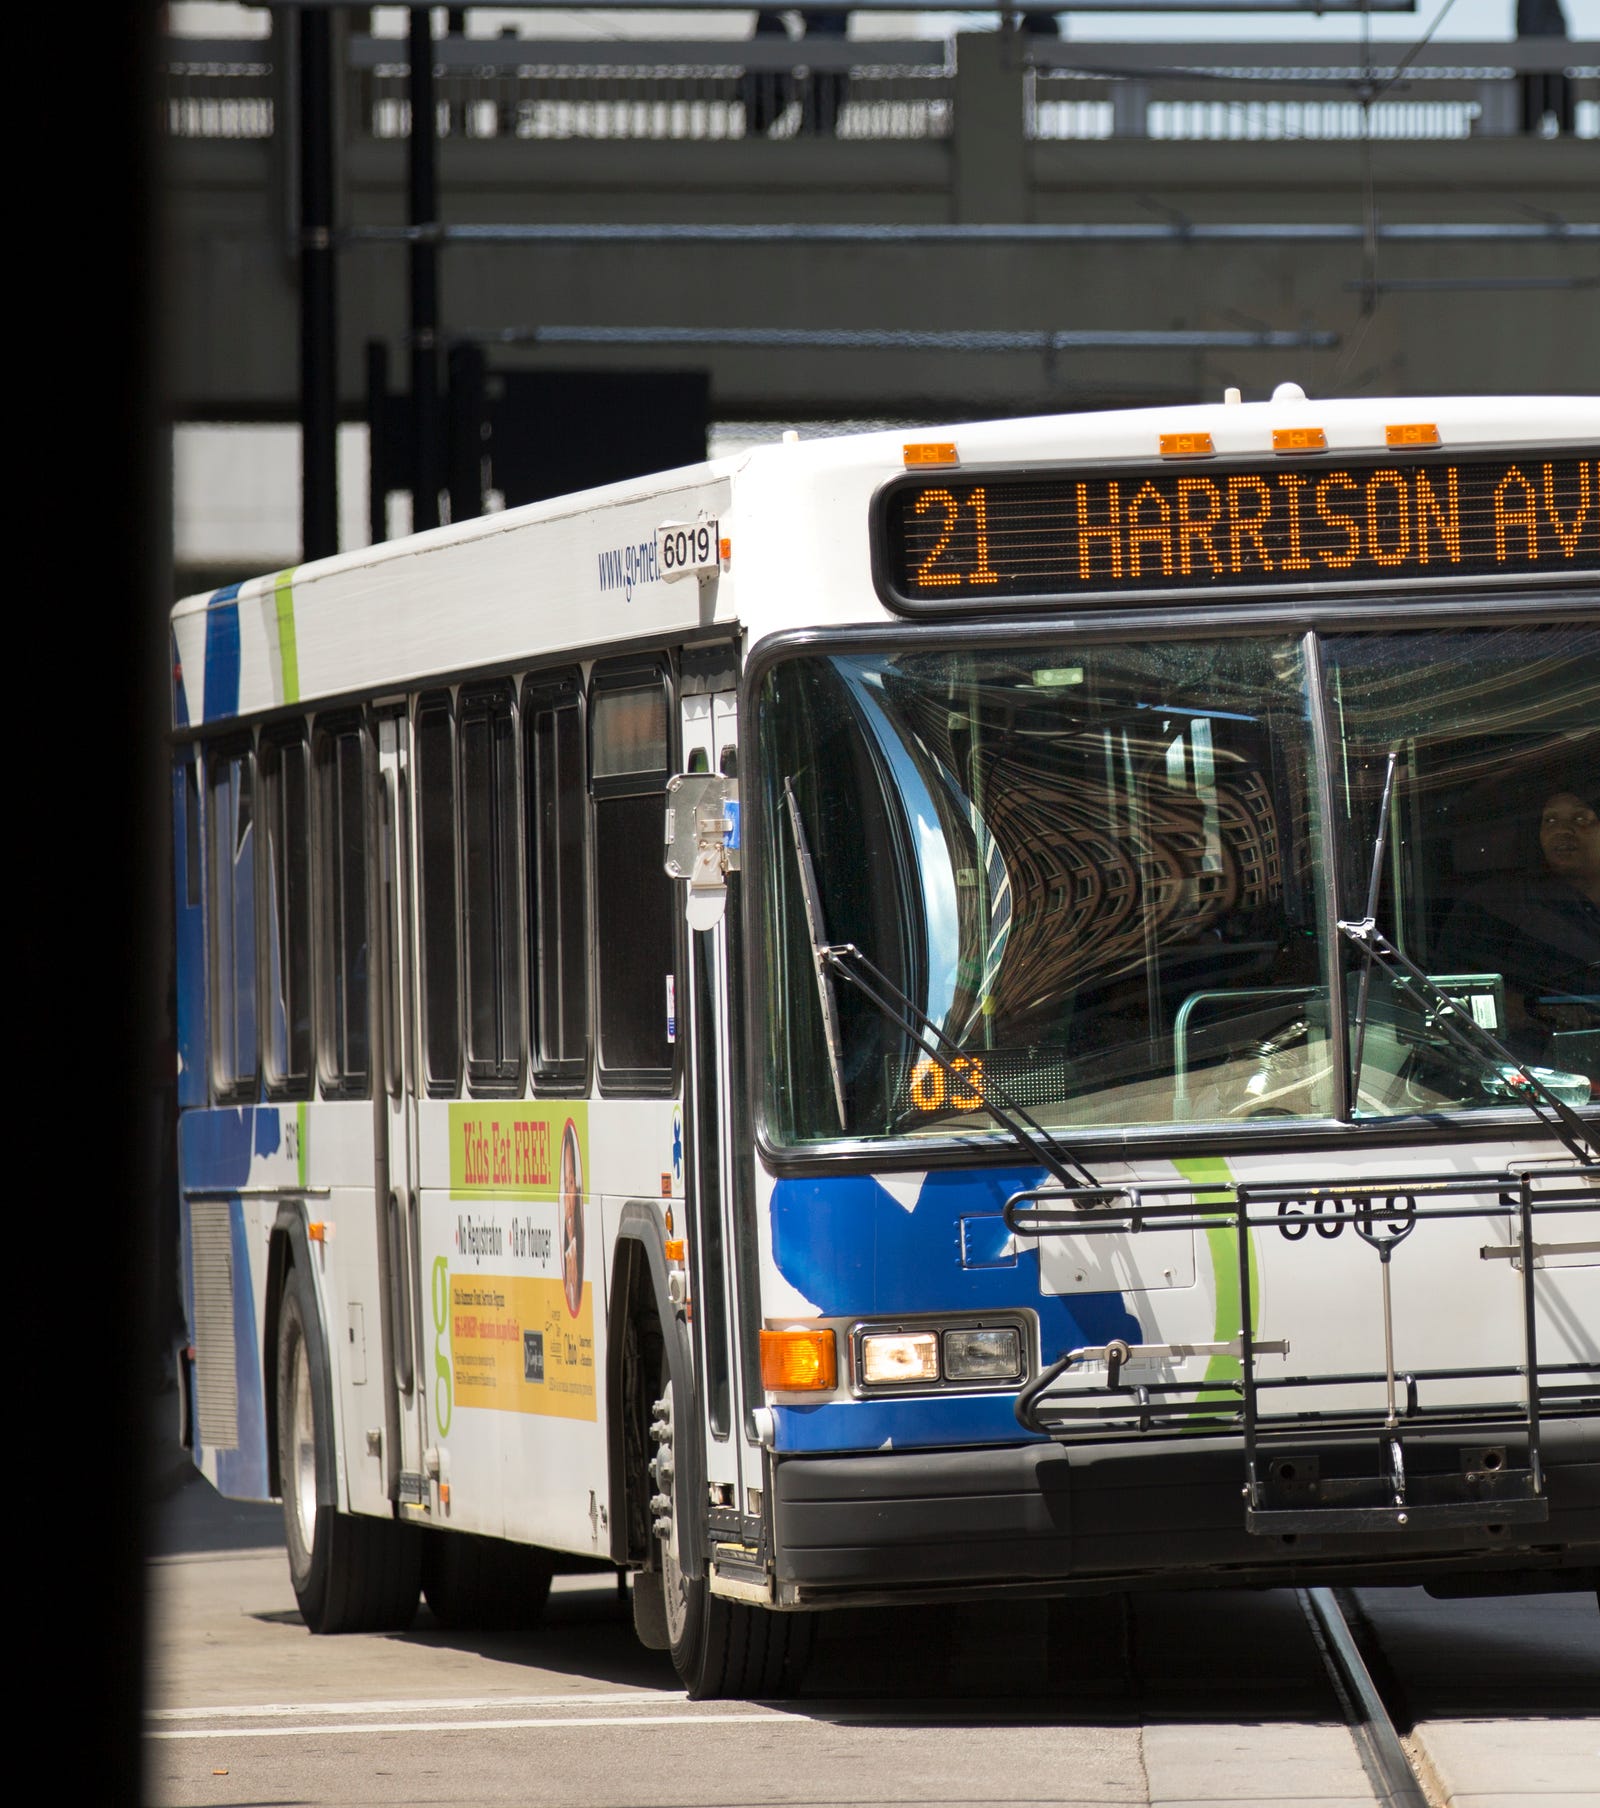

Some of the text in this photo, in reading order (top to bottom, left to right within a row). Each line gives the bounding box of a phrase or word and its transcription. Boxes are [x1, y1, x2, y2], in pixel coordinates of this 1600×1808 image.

[664, 527, 709, 569] 6019
[915, 487, 997, 586] 21
[1077, 465, 1461, 578] HARRISON
[911, 1057, 984, 1110] 03
[463, 1120, 551, 1185] Kids Eat FREE!
[467, 1214, 503, 1266] Registration
[527, 1216, 552, 1269] Younger
[1277, 1194, 1417, 1241] 6019
